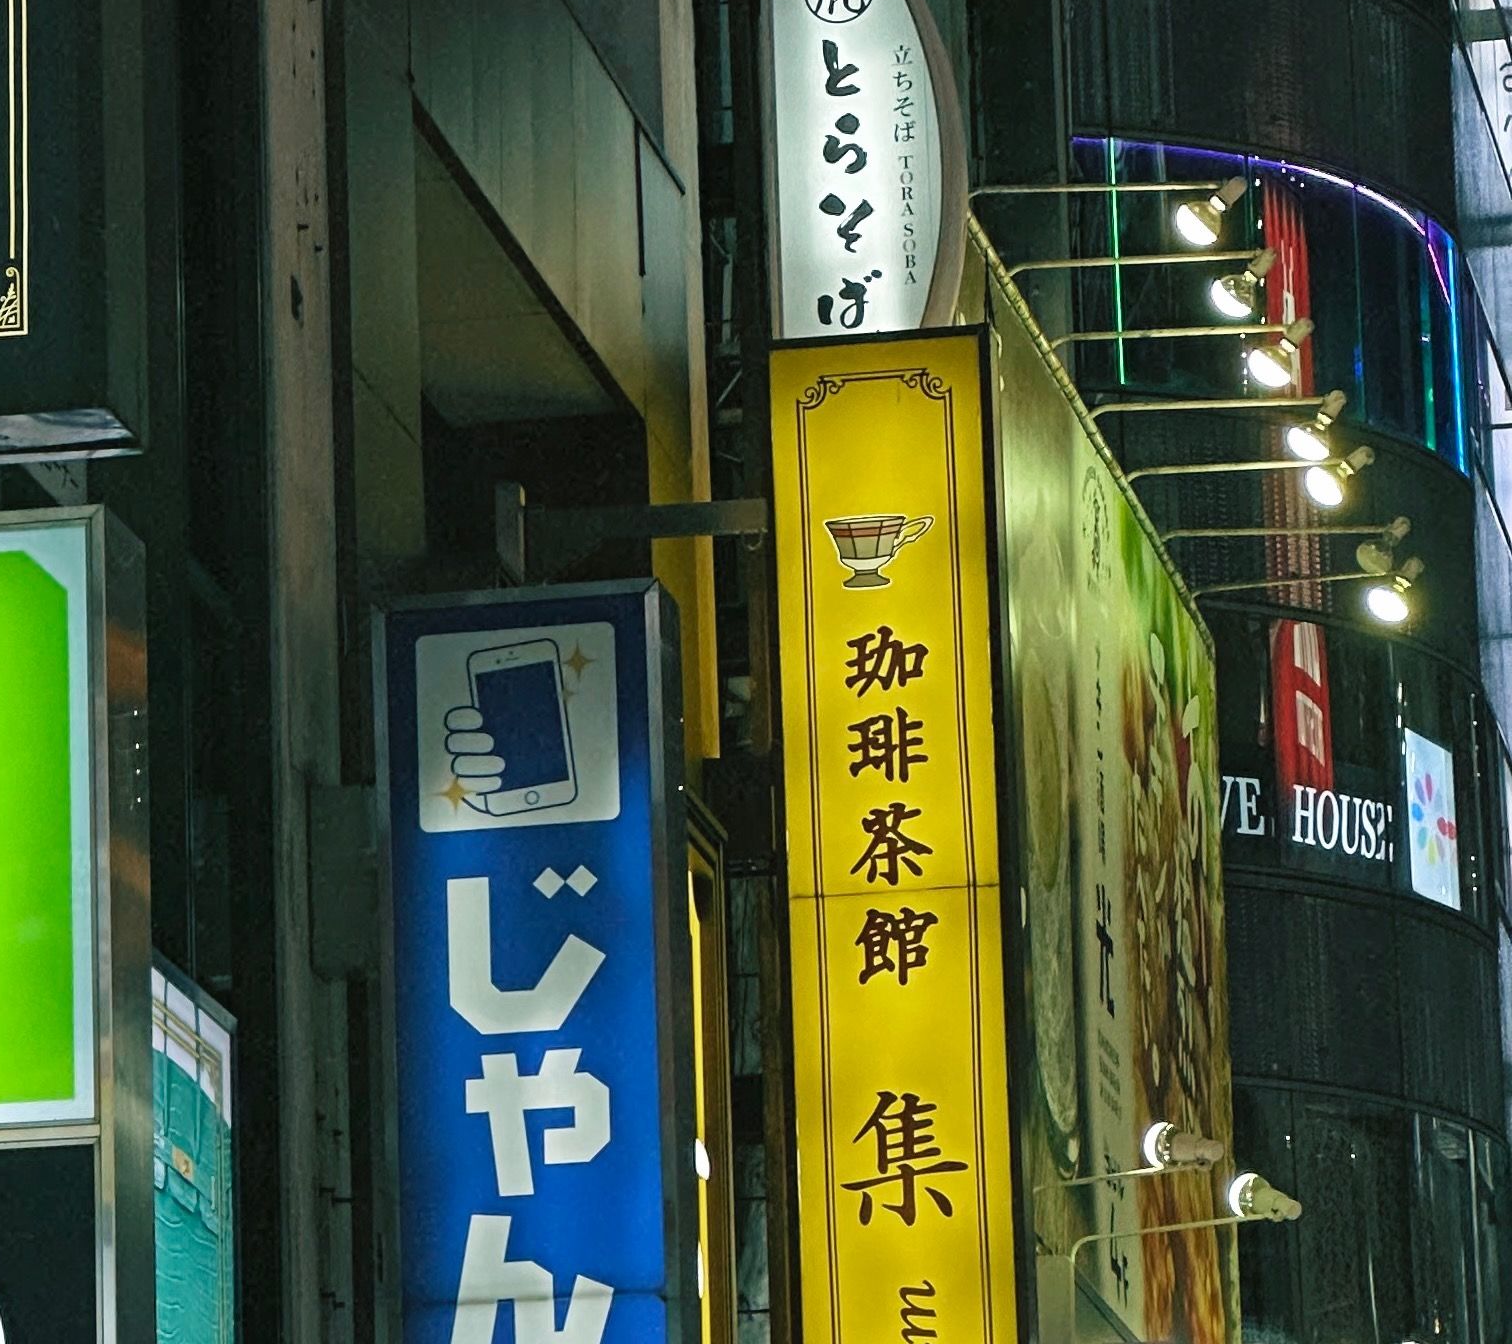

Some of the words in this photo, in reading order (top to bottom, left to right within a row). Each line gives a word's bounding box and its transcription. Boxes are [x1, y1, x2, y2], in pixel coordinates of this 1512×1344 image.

[891, 44, 916, 143] 立ちそば
[817, 39, 883, 329] とらそば
[897, 154, 916, 217] TORA
[902, 222, 918, 286] SOBA
[844, 624, 938, 987] 珈琲茶館
[840, 1089, 969, 1228] 集
